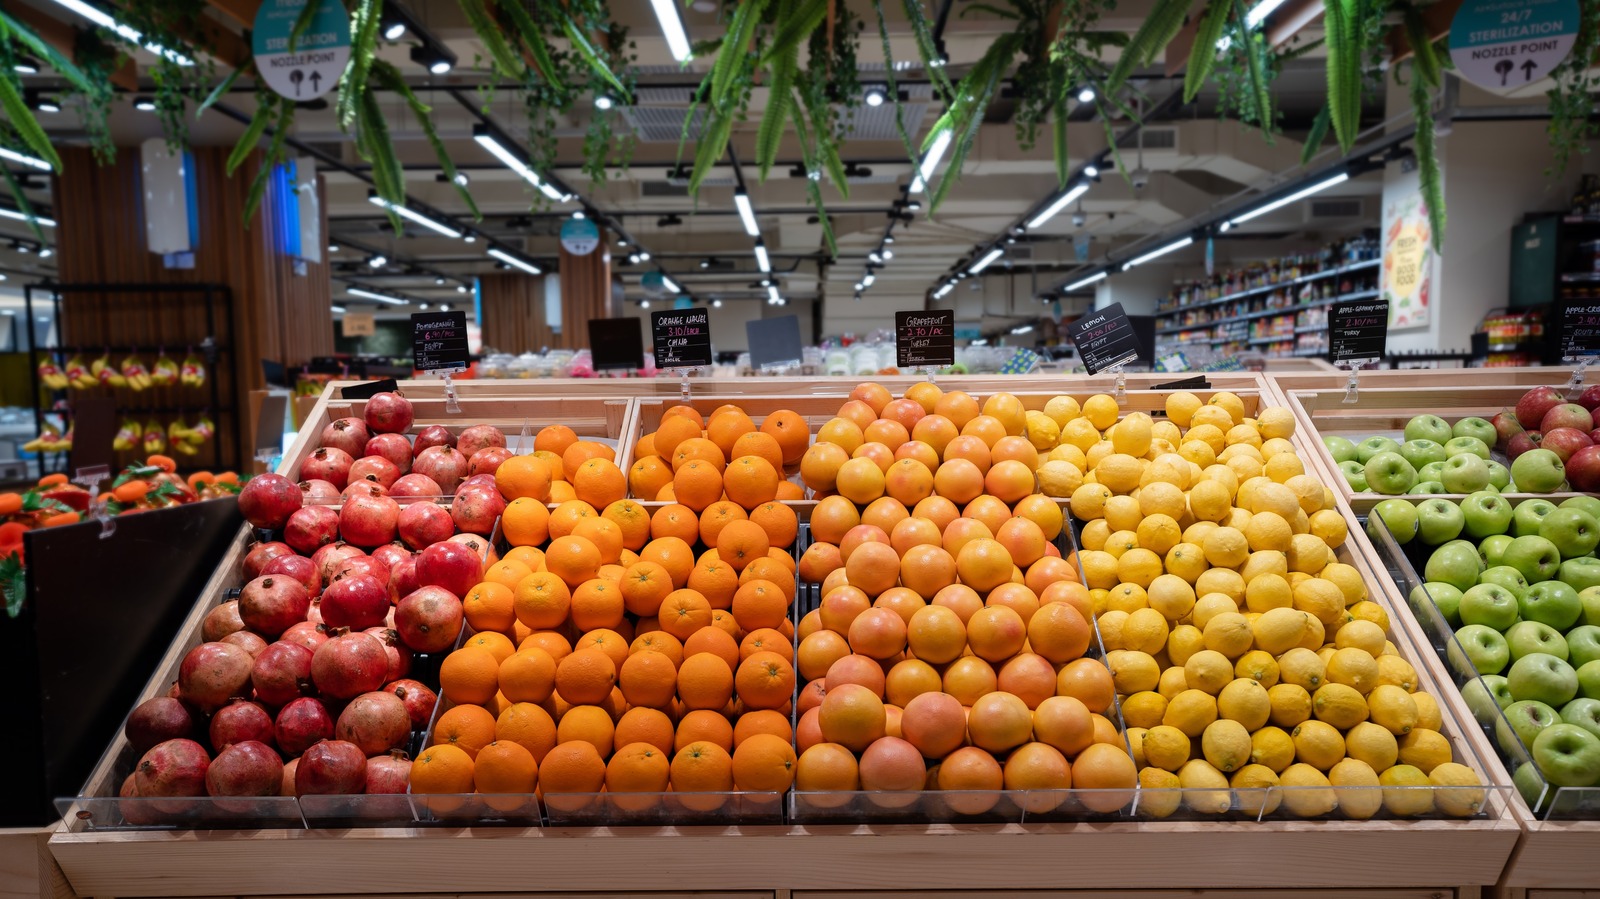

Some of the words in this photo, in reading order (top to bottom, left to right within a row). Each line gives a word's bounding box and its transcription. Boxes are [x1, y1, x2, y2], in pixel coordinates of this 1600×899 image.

[1501, 9, 1532, 24] 24/7
[1469, 21, 1563, 43] STERILIZATION
[1472, 45, 1517, 60] NOZZLE
[1520, 39, 1559, 54] POINT
[270, 54, 305, 68] NOZZLE
[307, 51, 335, 65] POINT
[658, 316, 683, 326] ORANGE
[906, 315, 947, 327] GRAPEFRUIT
[1080, 314, 1106, 331] LEMON
[667, 337, 688, 347] CHINA
